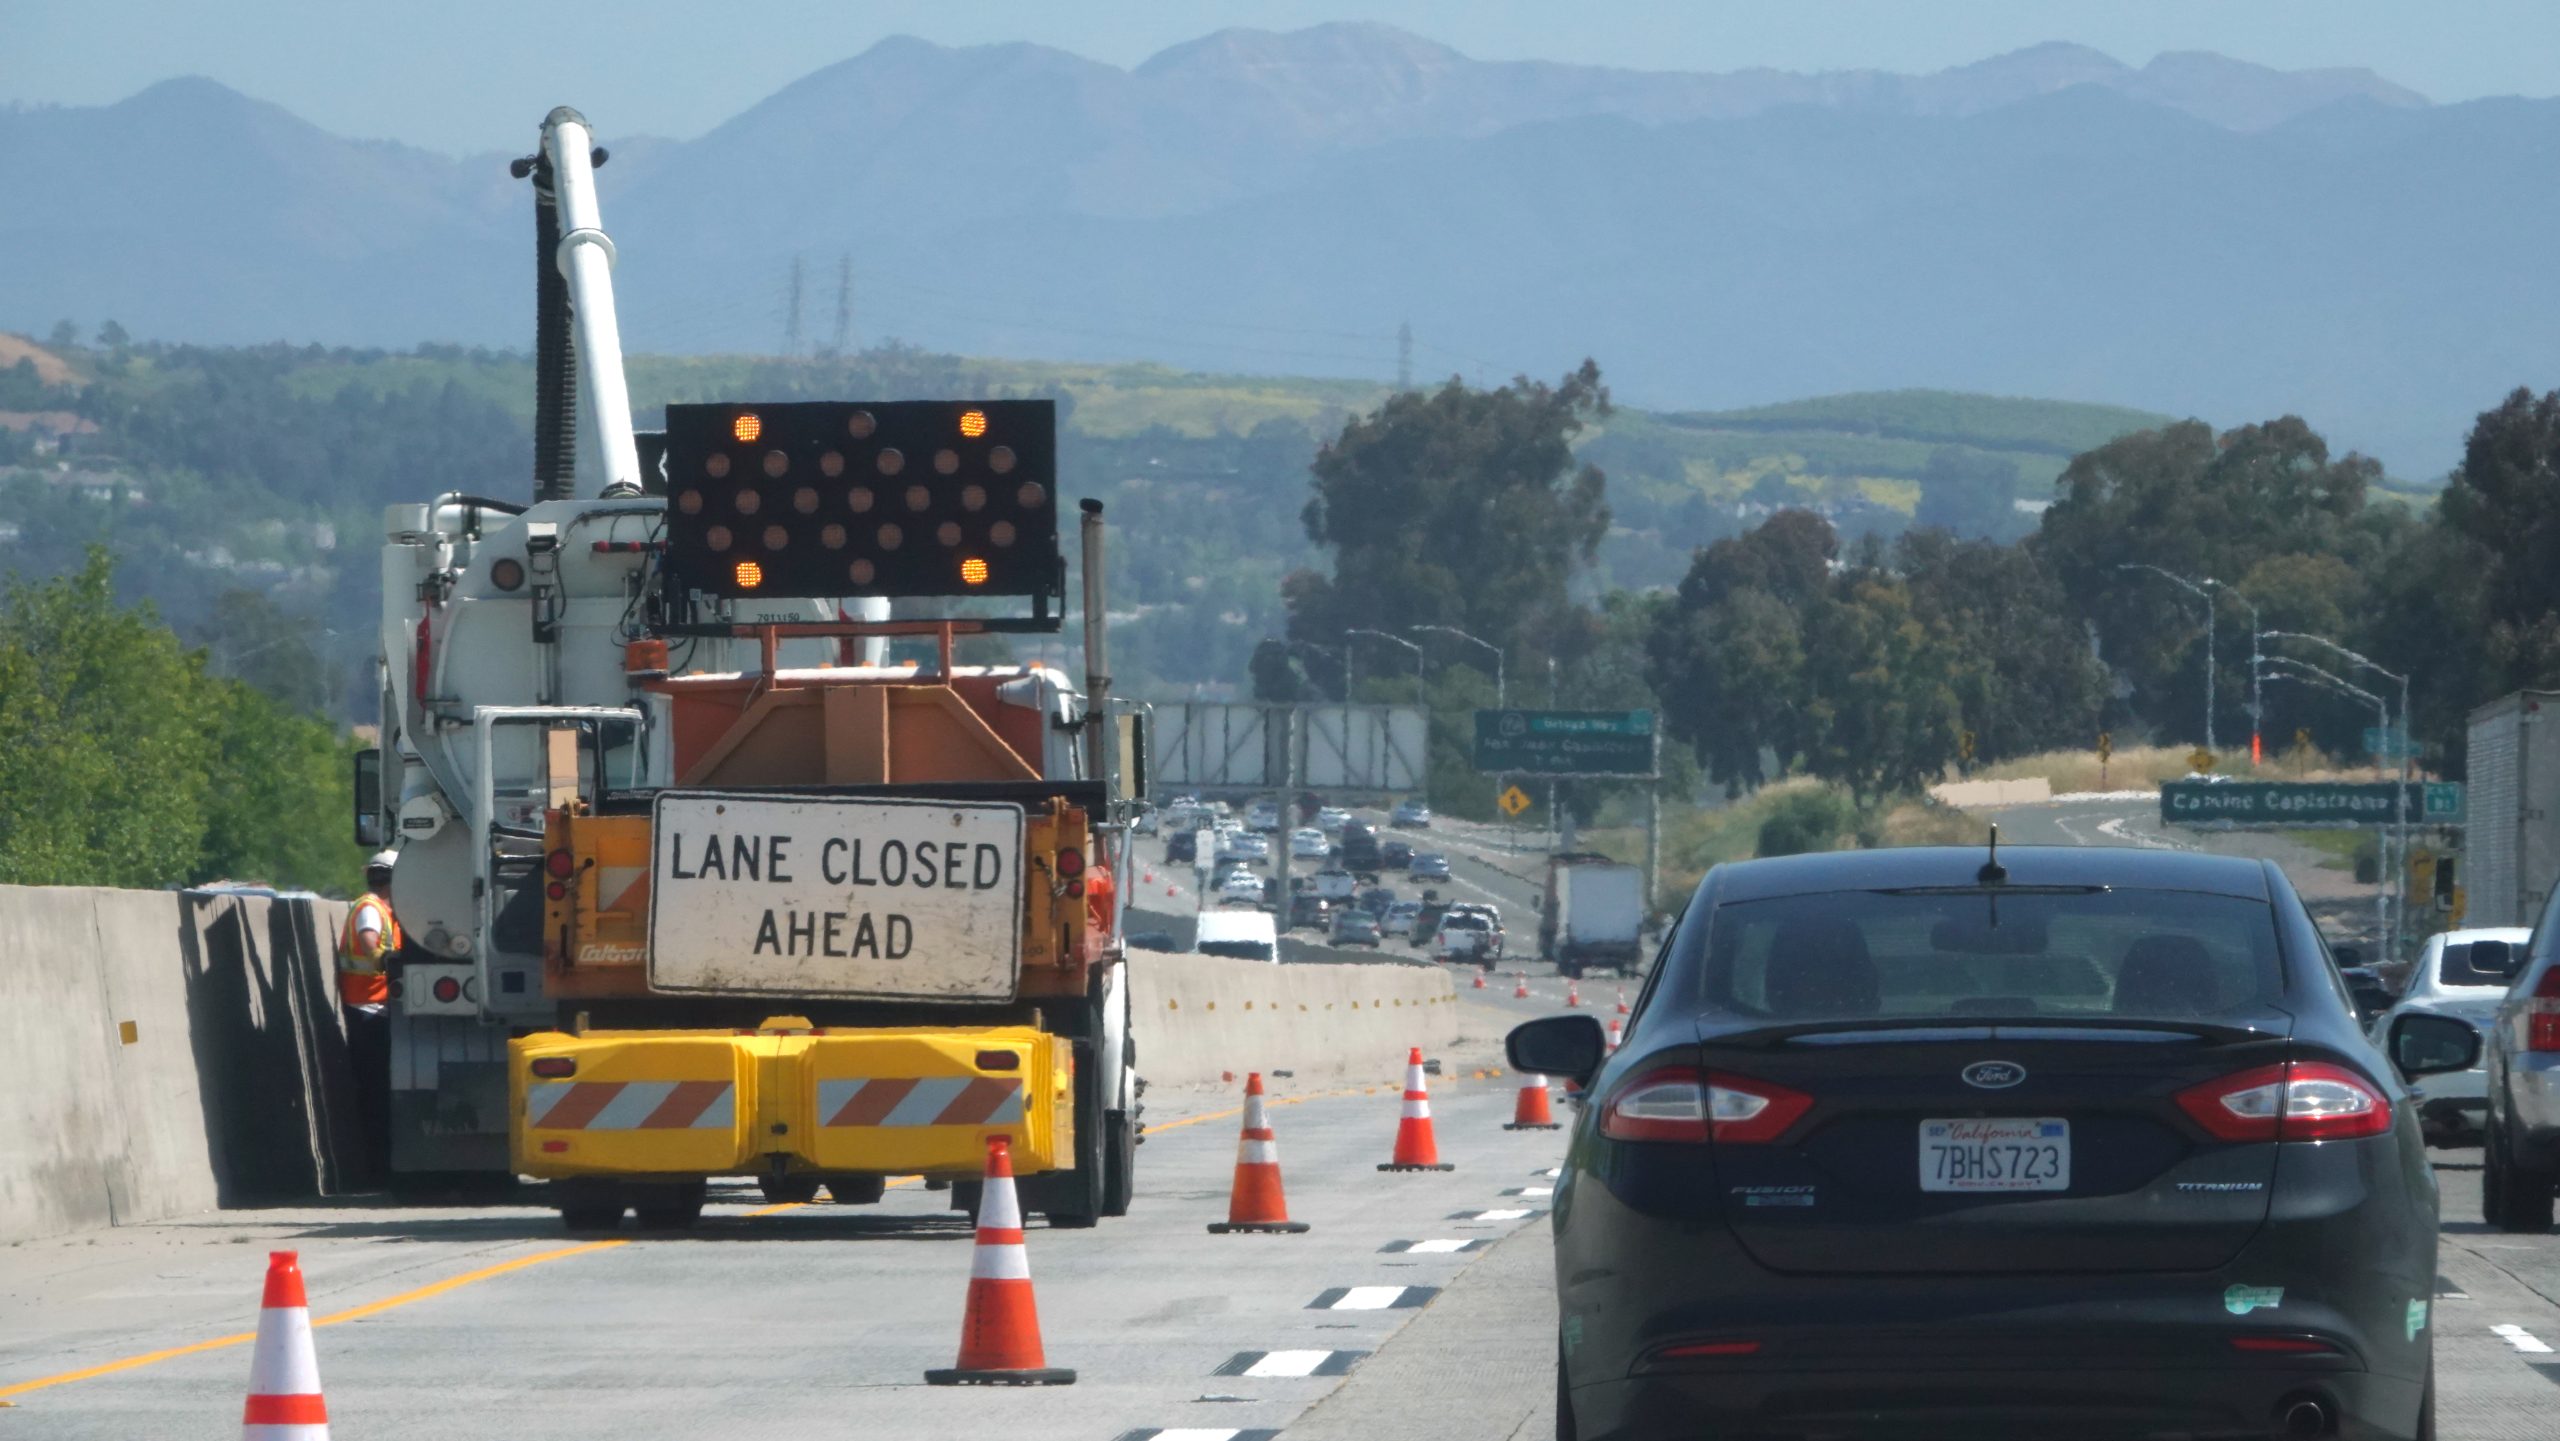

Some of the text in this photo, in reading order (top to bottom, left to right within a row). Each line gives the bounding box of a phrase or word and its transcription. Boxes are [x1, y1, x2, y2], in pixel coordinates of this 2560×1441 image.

[671, 832, 1001, 890] LANE CLOSED
[753, 908, 914, 960] AHEAD
[579, 943, 648, 962] Caltran
[1976, 1066, 2012, 1082] Ford
[1951, 1121, 2041, 1144] California
[1930, 1145, 2059, 1179] 7BHS723
[1730, 1185, 1817, 1194] FUSION
[2176, 1182, 2263, 1191] TITANIUM
